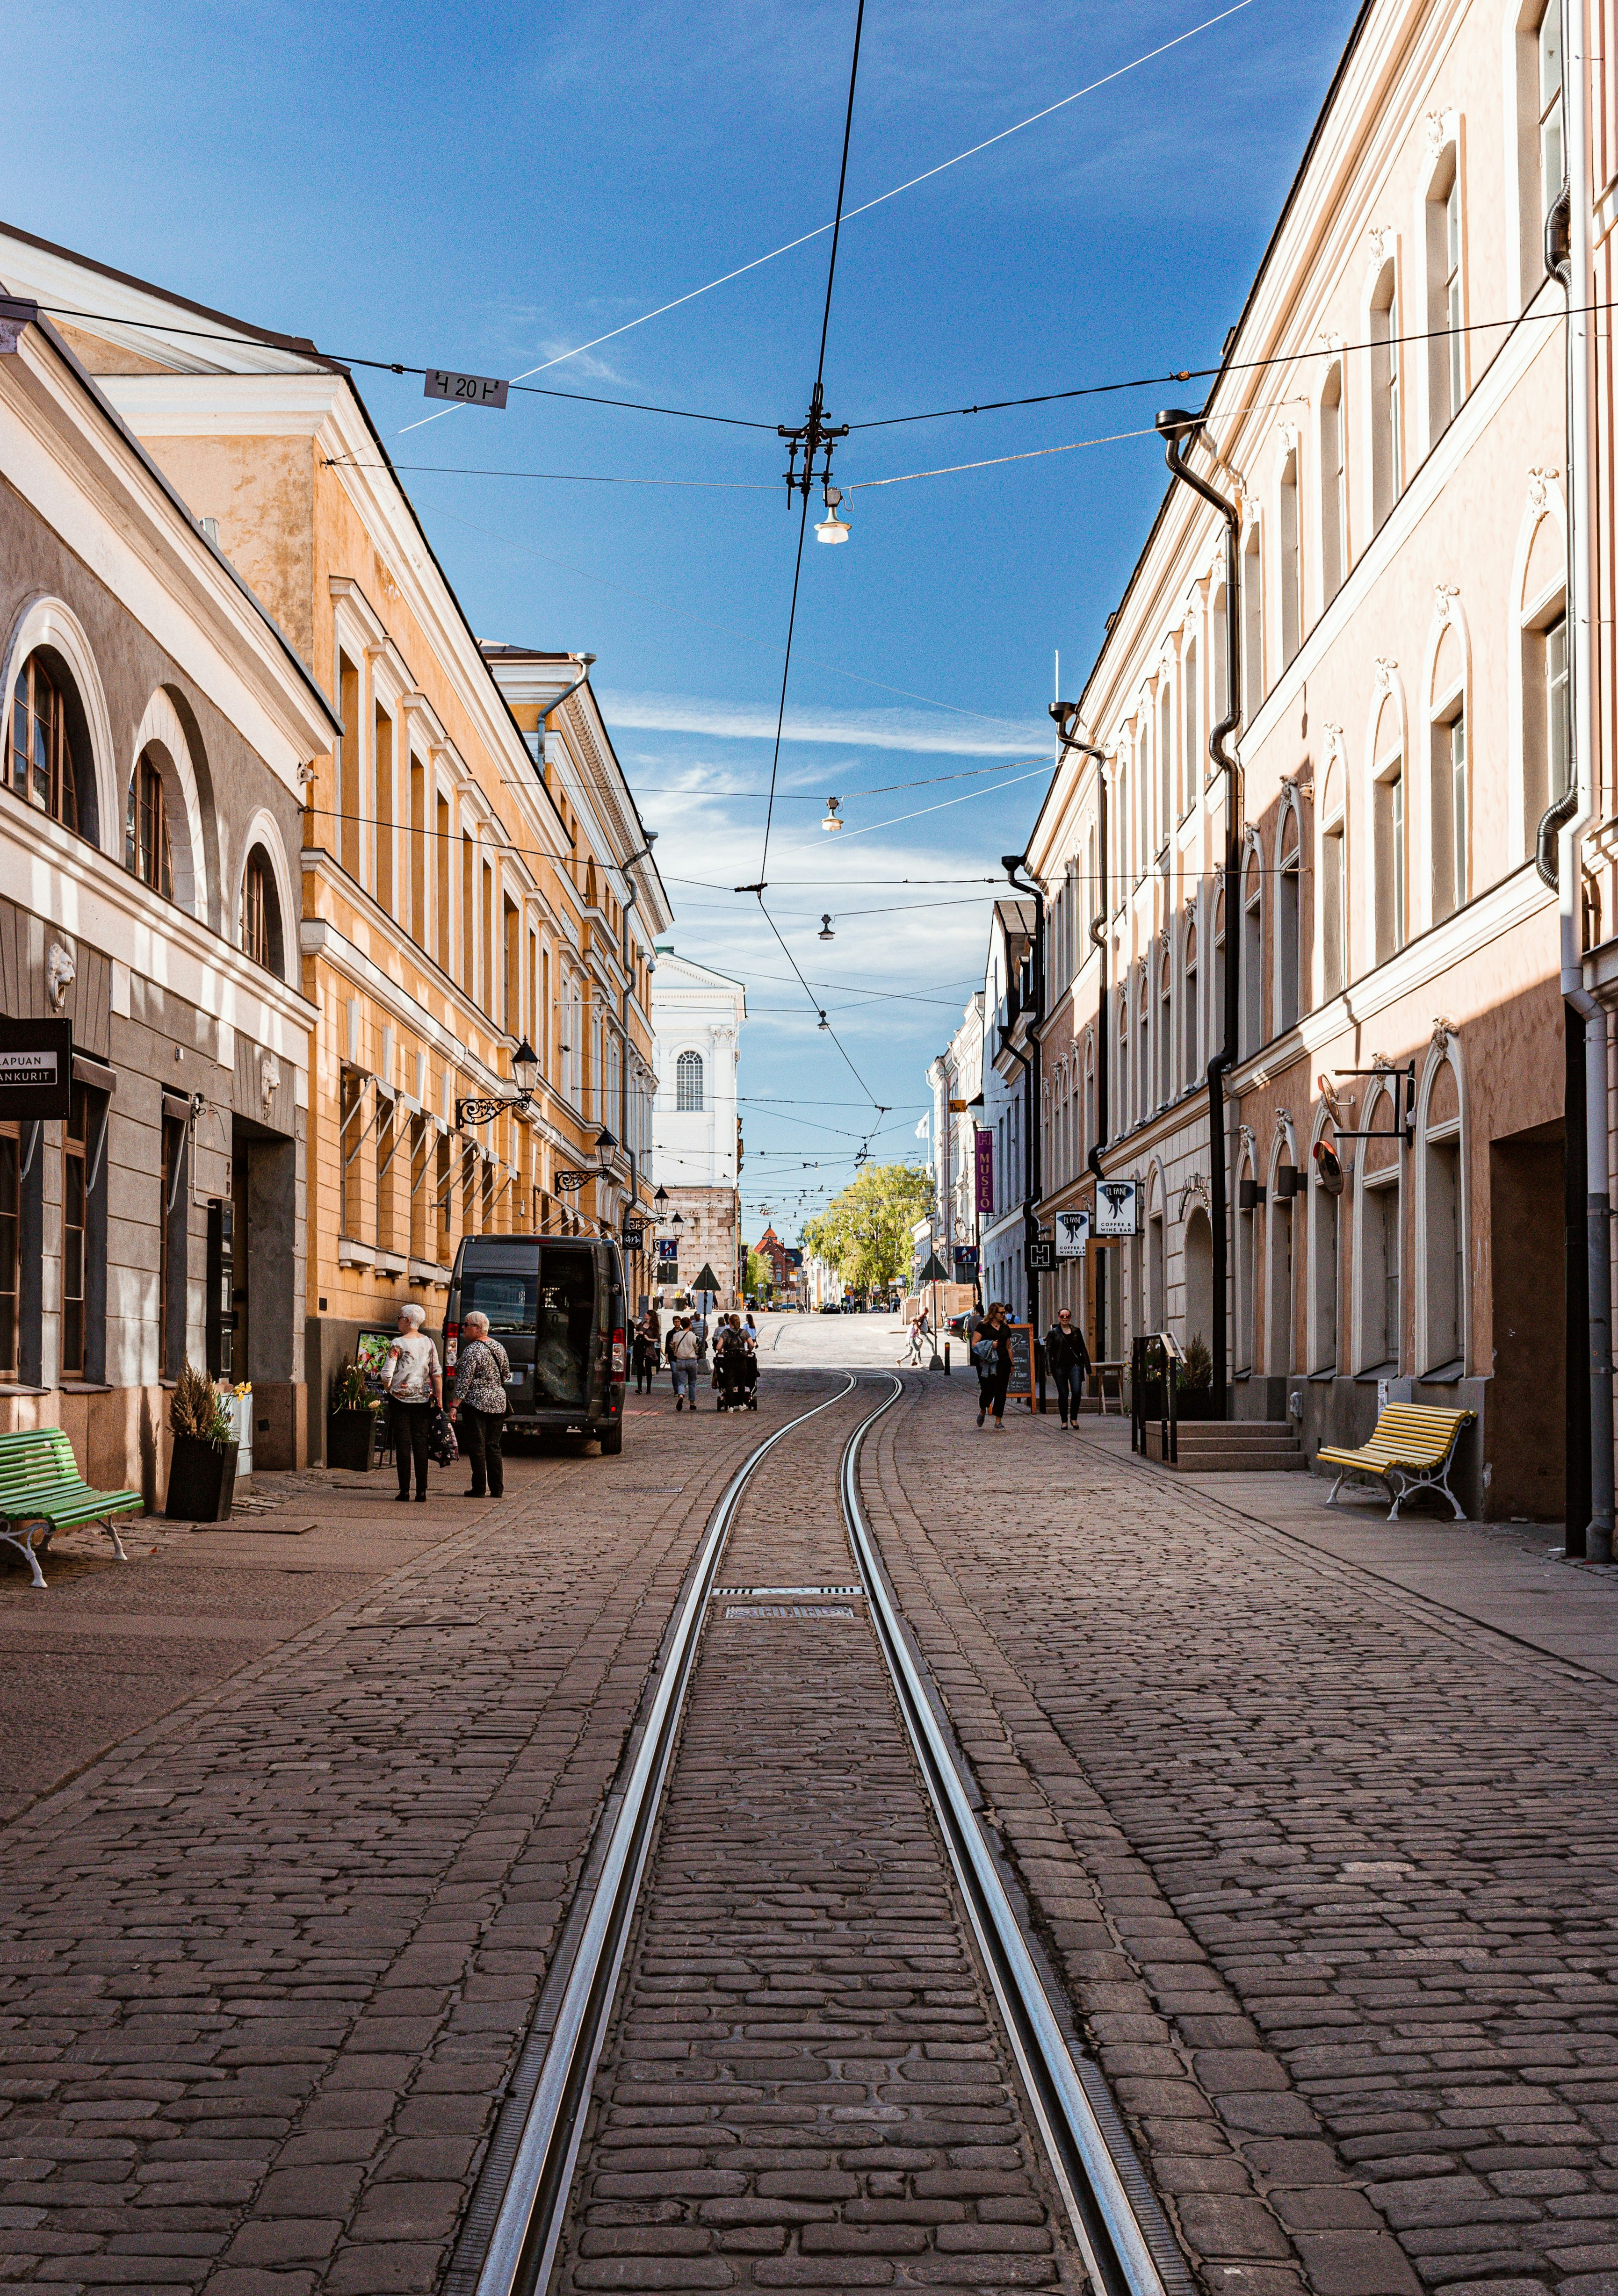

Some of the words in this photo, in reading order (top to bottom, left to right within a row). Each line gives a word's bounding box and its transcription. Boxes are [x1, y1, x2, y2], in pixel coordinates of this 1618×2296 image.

[455, 378, 477, 398] 20
[0, 1057, 41, 1065] APUAN
[980, 1153, 990, 1208] MUSEO
[1106, 1187, 1112, 1196] EL
[1113, 1187, 1127, 1196] FANT
